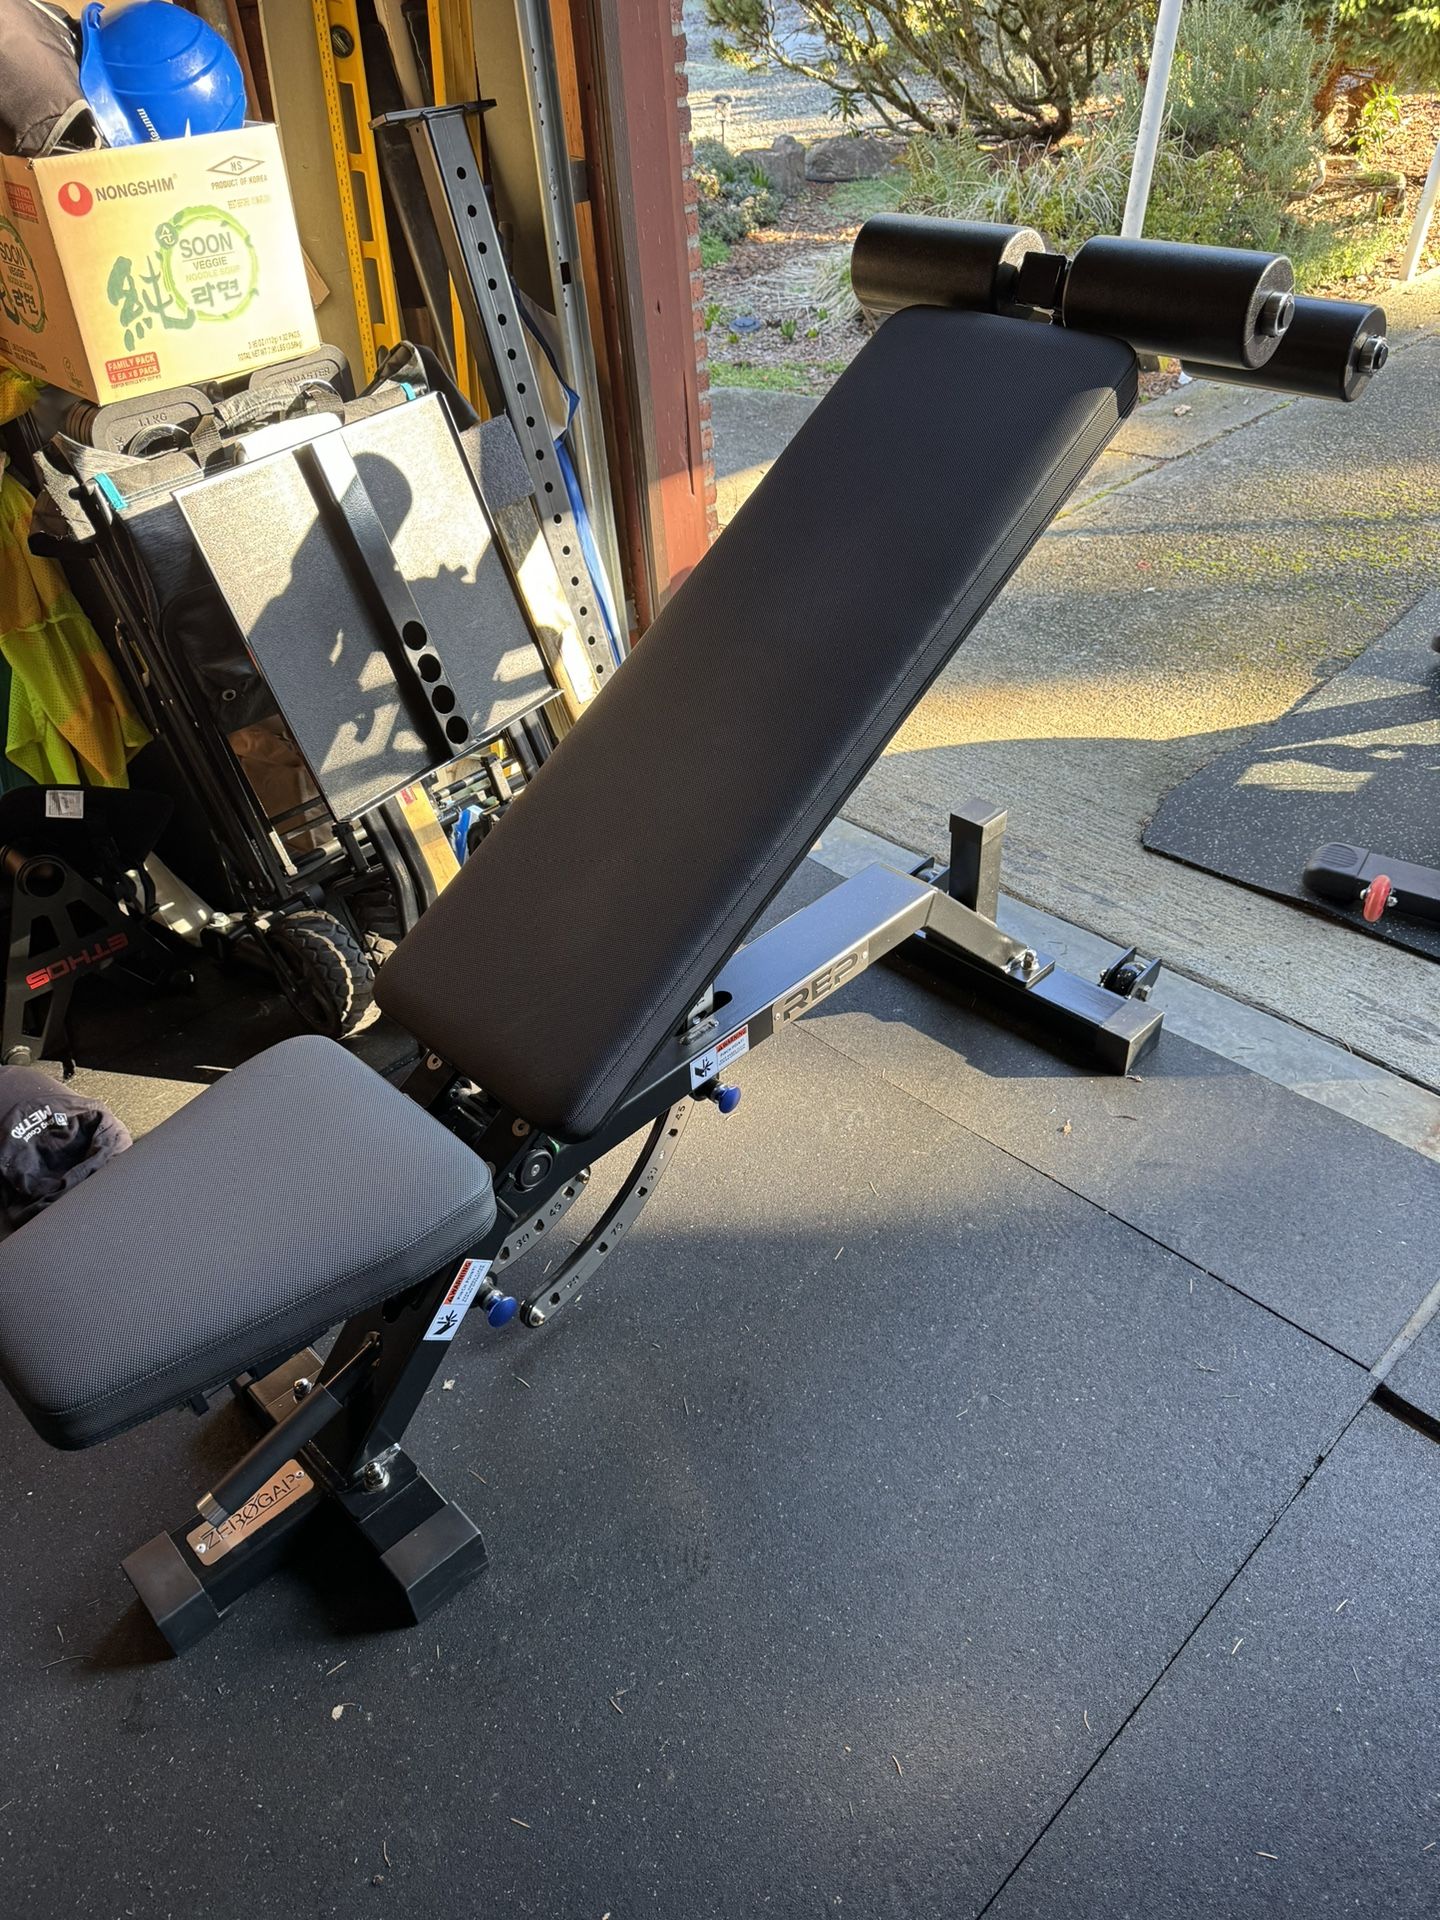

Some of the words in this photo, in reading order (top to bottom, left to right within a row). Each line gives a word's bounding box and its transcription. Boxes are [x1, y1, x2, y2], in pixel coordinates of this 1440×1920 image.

[230, 160, 244, 172] NS
[95, 177, 175, 202] NONGSHIM
[210, 178, 238, 190] PRODUCT
[239, 177, 247, 186] OF
[248, 174, 268, 185] KOREA
[179, 231, 233, 258] SOON
[193, 256, 228, 271] VEGGIE
[186, 269, 218, 282] NOODLE
[191, 278, 242, 307] 라면
[107, 357, 135, 372] FAMILY
[135, 354, 156, 366] PACK
[139, 365, 158, 376] PACK
[25, 932, 128, 990] ETHOS
[783, 953, 859, 1021] REP
[11, 1105, 52, 1139] METRO
[549, 1203, 563, 1217] 45
[611, 1222, 623, 1236] 75
[515, 1233, 530, 1249] 30
[449, 1261, 472, 1294] WARNING
